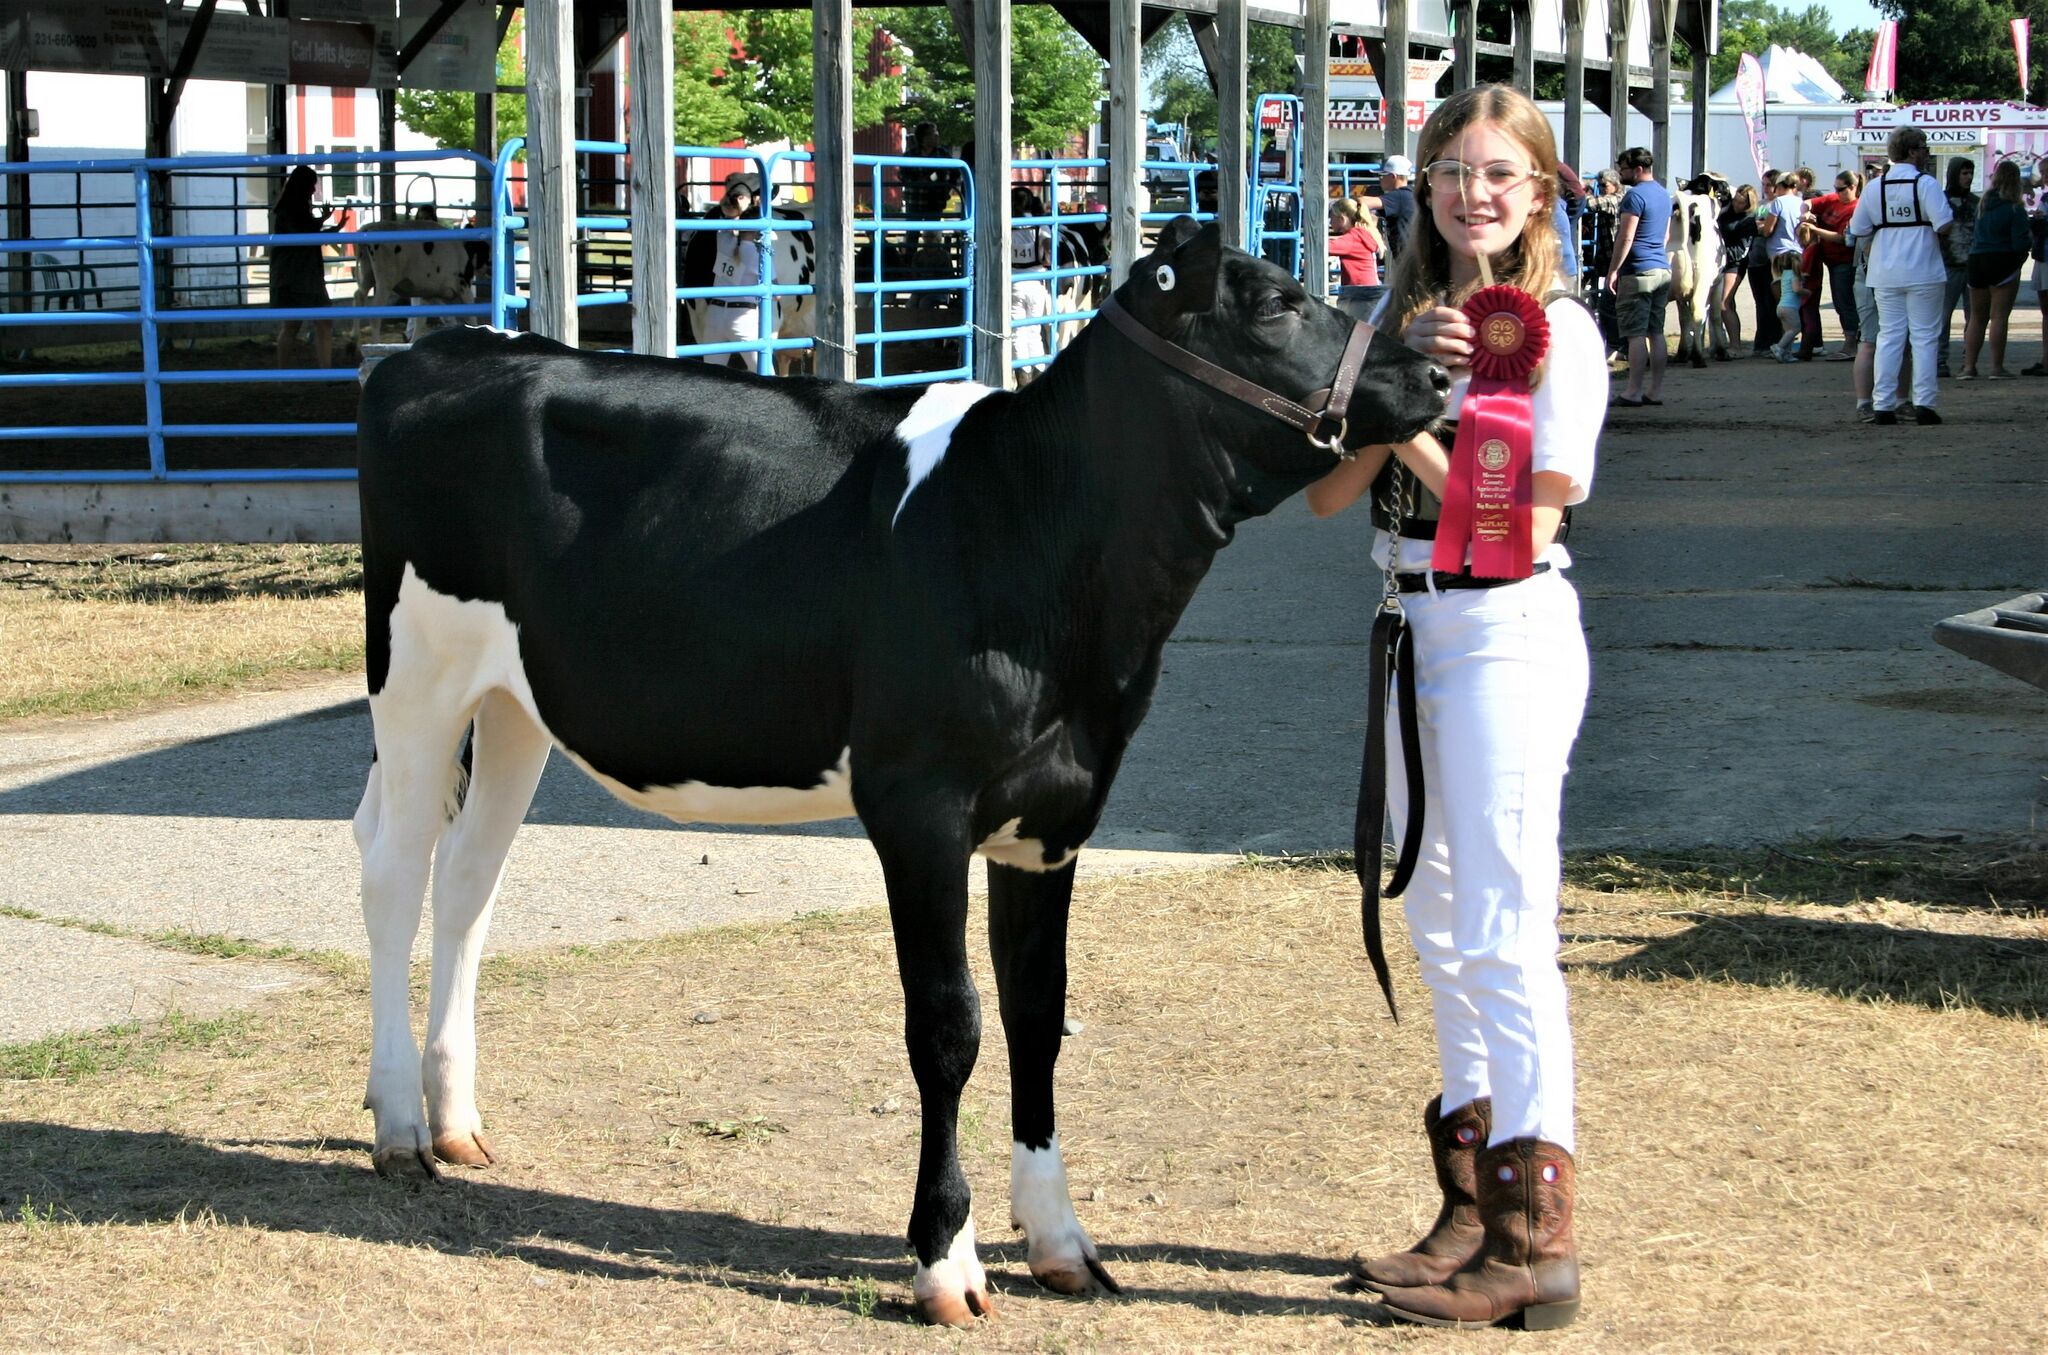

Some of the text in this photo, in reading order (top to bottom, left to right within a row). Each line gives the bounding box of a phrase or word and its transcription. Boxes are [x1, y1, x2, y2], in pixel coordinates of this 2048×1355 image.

[292, 40, 312, 61] Carl
[314, 41, 337, 63] Jefts
[338, 43, 371, 69] Agency
[1285, 101, 1377, 121] PZA
[1912, 108, 2001, 122] FLURRYS
[1889, 206, 1911, 217] 149
[1014, 247, 1032, 258] 141
[722, 262, 735, 277] 18
